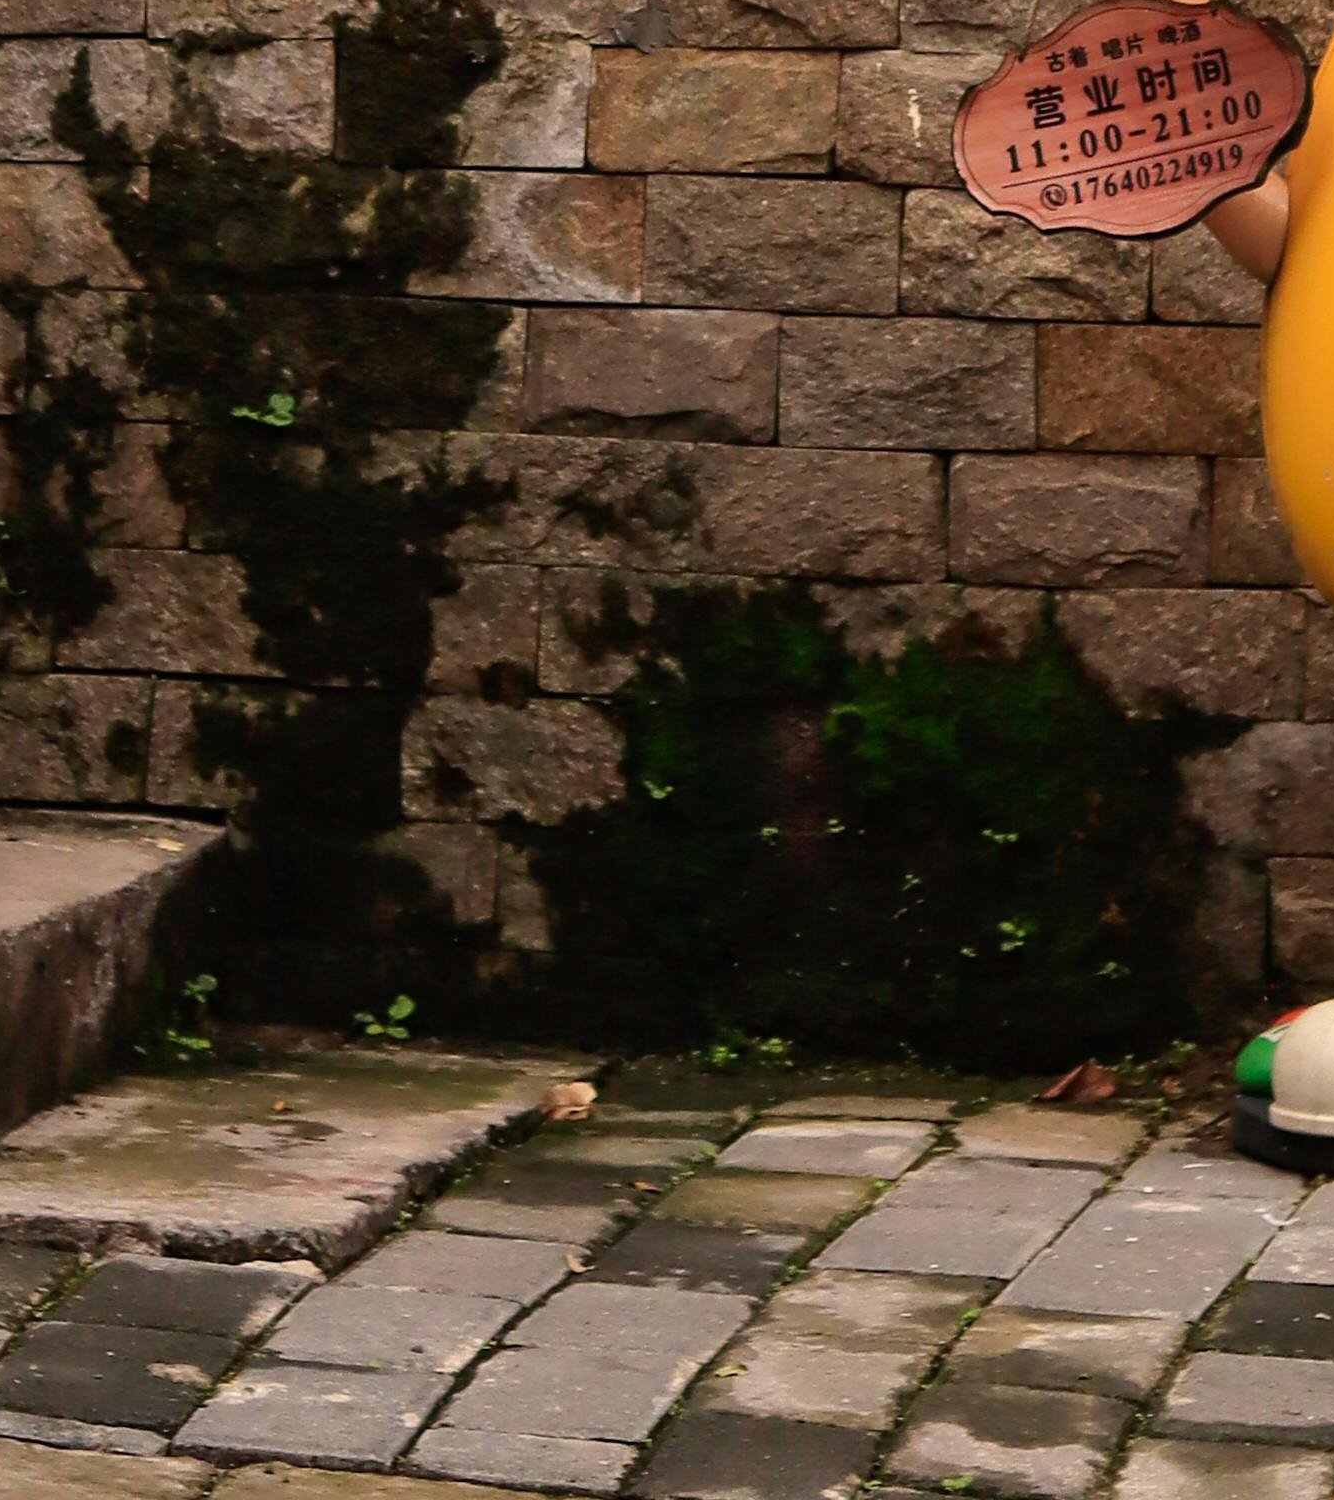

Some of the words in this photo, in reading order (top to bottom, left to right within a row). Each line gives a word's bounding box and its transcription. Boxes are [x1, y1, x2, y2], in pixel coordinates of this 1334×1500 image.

[1100, 33, 1145, 61] 唱片
[1157, 19, 1202, 47] 啤酒
[1025, 48, 1232, 130] 营业时间
[1006, 90, 1262, 174] 11:00-21:00
[1071, 143, 1244, 205] 17640224919
